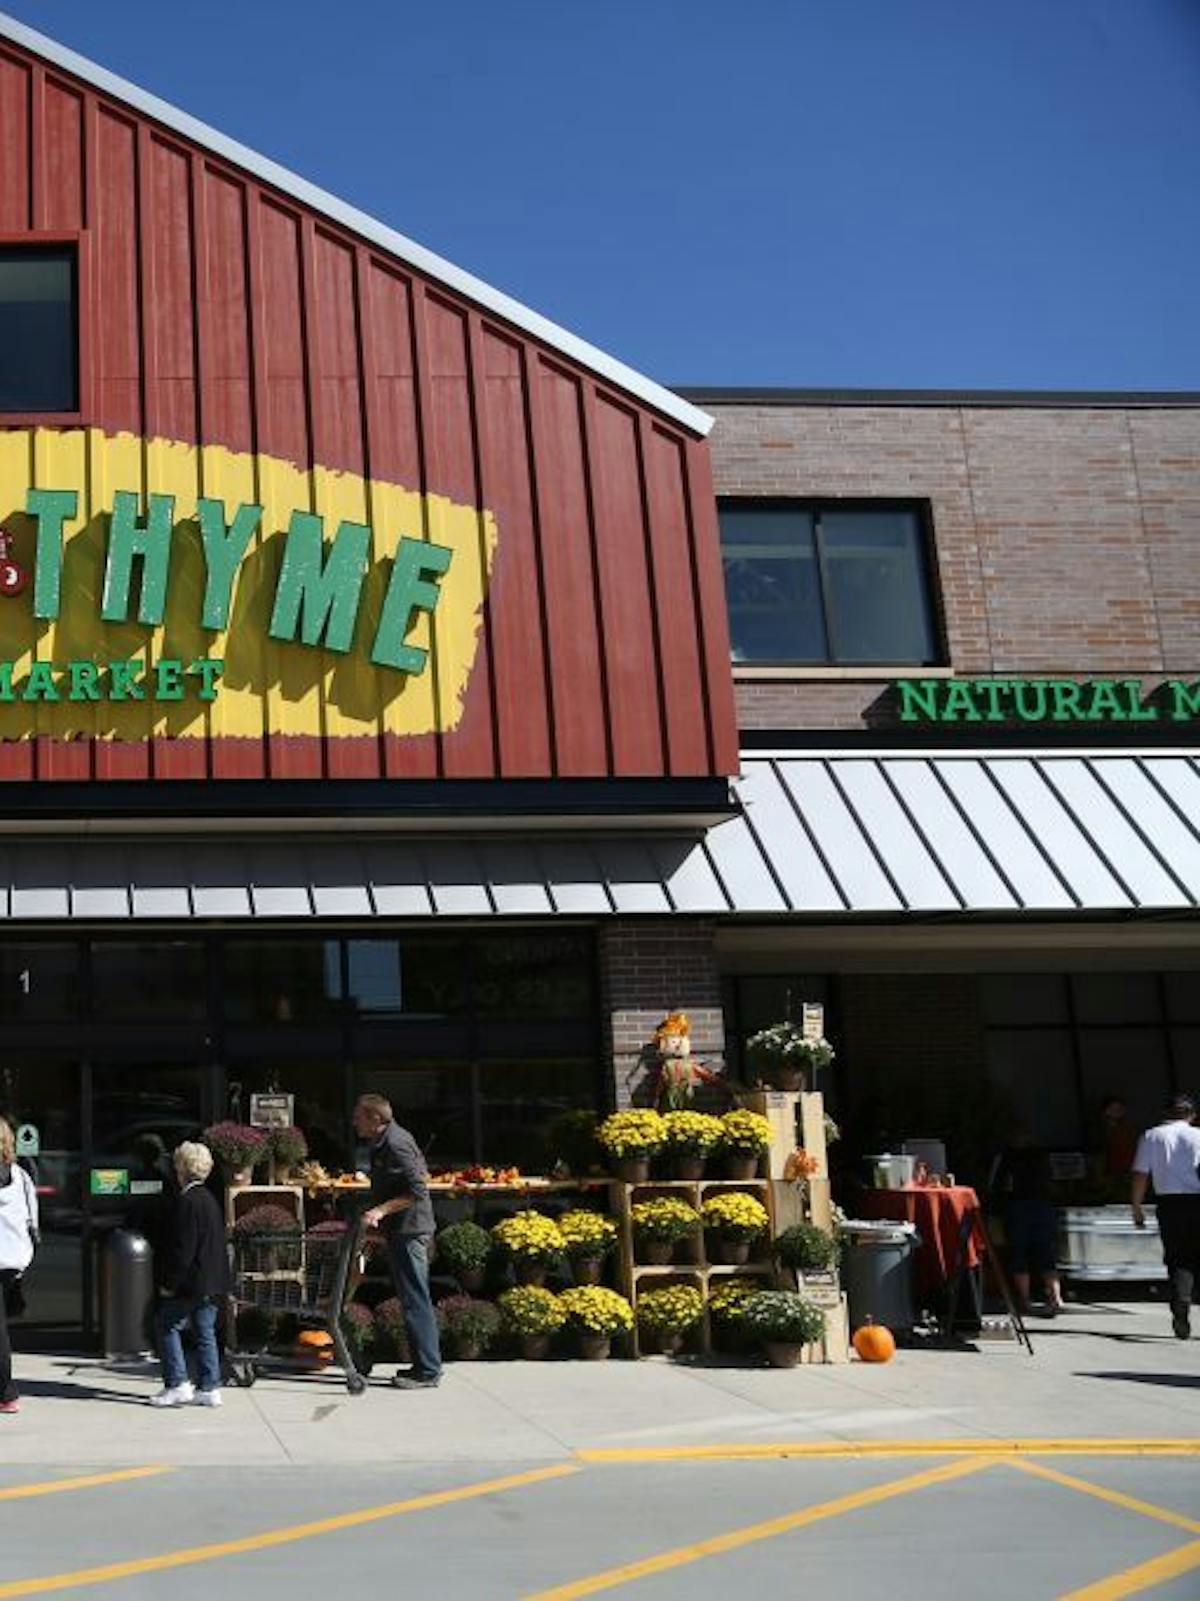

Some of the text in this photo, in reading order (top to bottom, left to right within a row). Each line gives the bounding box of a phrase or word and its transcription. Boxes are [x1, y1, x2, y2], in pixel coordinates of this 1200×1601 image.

[26, 488, 453, 675] THYME
[898, 679, 1158, 722] NATURAL
[19, 969, 30, 994] 1
